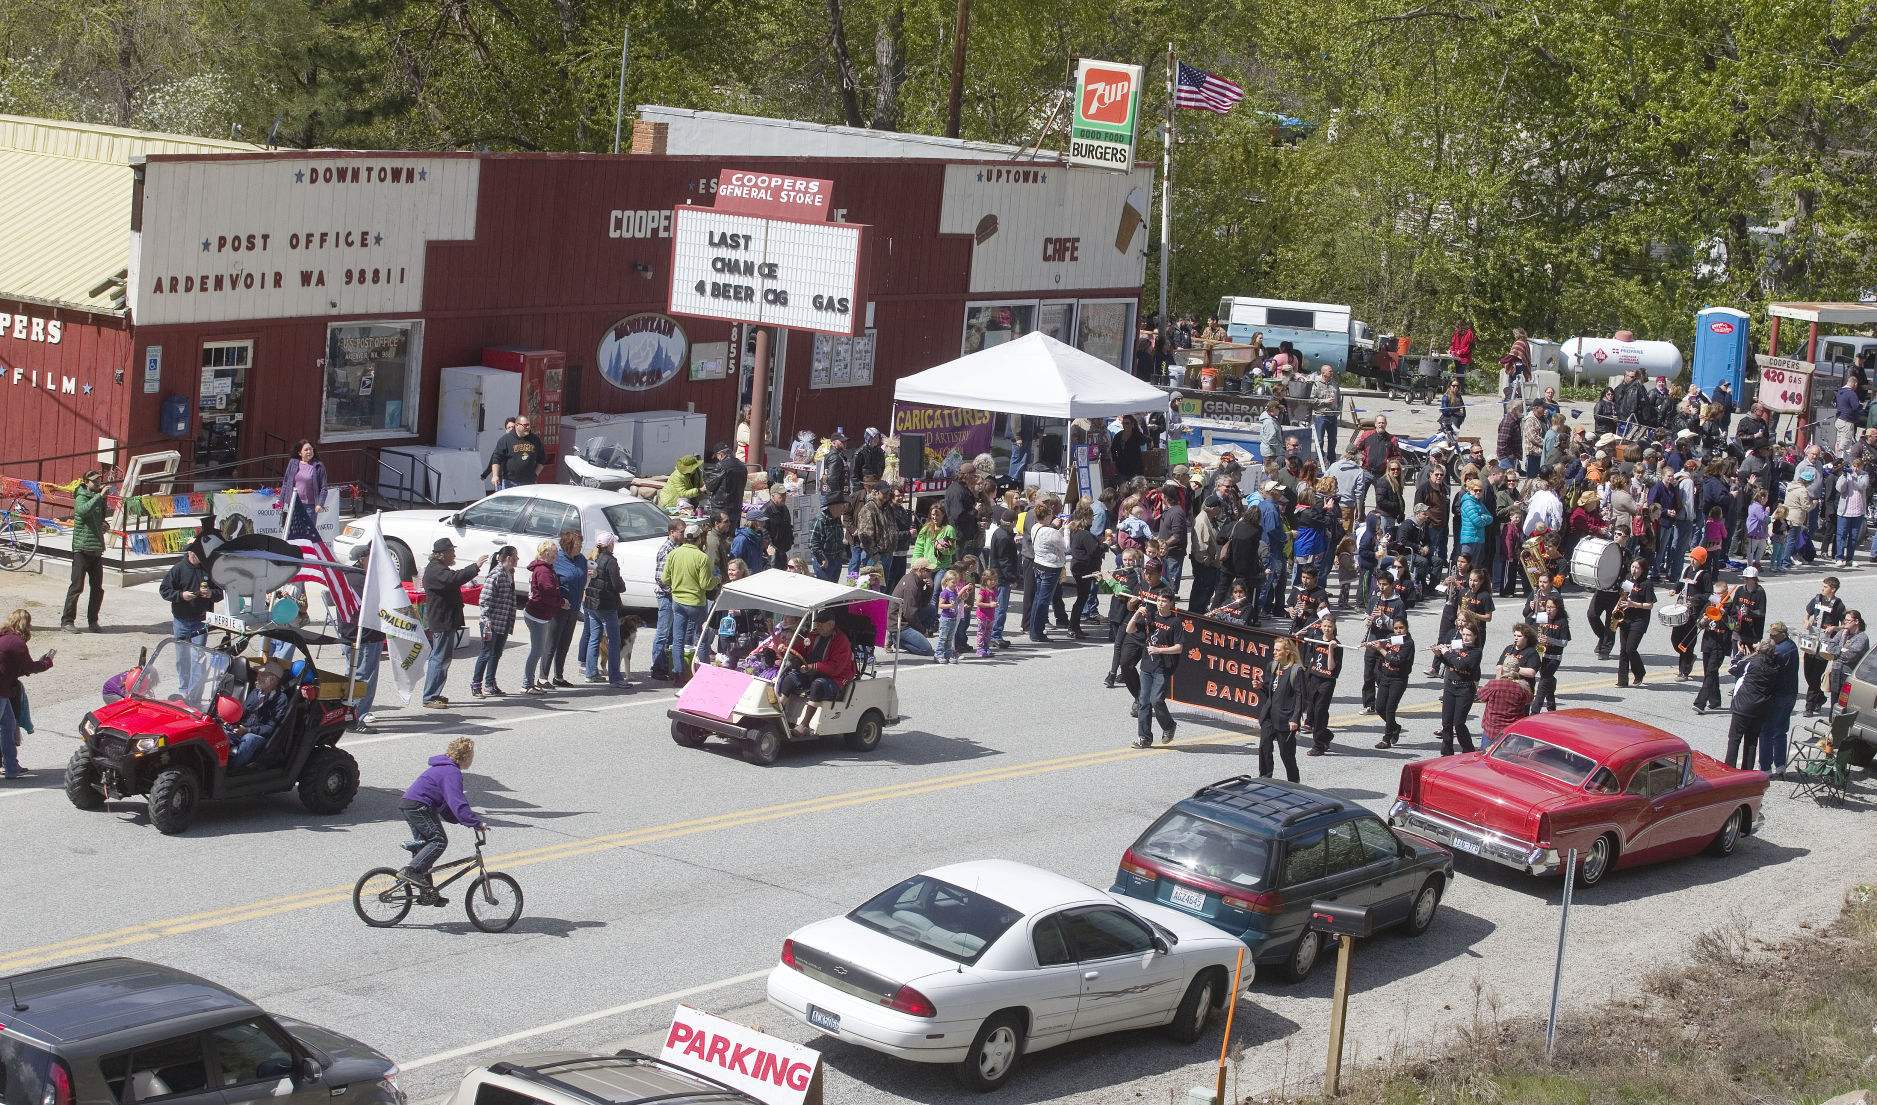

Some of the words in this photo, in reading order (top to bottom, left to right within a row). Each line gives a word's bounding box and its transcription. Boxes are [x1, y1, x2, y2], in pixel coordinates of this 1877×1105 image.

[1086, 81, 1128, 115] 7UP
[1080, 129, 1102, 140] GOOD
[1104, 132, 1125, 143] FOOD
[1072, 142, 1127, 163] BURGERS
[309, 166, 415, 185] DOWNTOWN
[731, 173, 820, 193] COOPERS
[986, 169, 1039, 184] UPTOWN
[779, 191, 823, 206] STORE
[608, 209, 675, 238] COOPE
[217, 233, 271, 253] POST
[289, 230, 370, 250] OFFICE
[708, 230, 752, 250] LAST
[1042, 236, 1080, 262] CAFE
[153, 272, 283, 294] ARDENVOIR
[300, 270, 326, 288] WA
[344, 268, 406, 286] 98811
[694, 280, 706, 297] 4
[710, 281, 755, 303] BEER
[812, 294, 850, 315] GAS
[727, 321, 739, 374] 855
[1769, 358, 1801, 370] COOPERS
[13, 367, 76, 395] FILM
[1763, 368, 1785, 384] 420
[1788, 375, 1802, 385] GAS
[895, 408, 991, 431] CARICATURES
[214, 615, 236, 629] HERBIE
[378, 608, 418, 632] SWALLOW
[1201, 628, 1270, 658] ENTIAT
[1206, 654, 1264, 682] TIGER
[1205, 681, 1260, 706] BAND
[665, 1020, 812, 1092] PARKING
